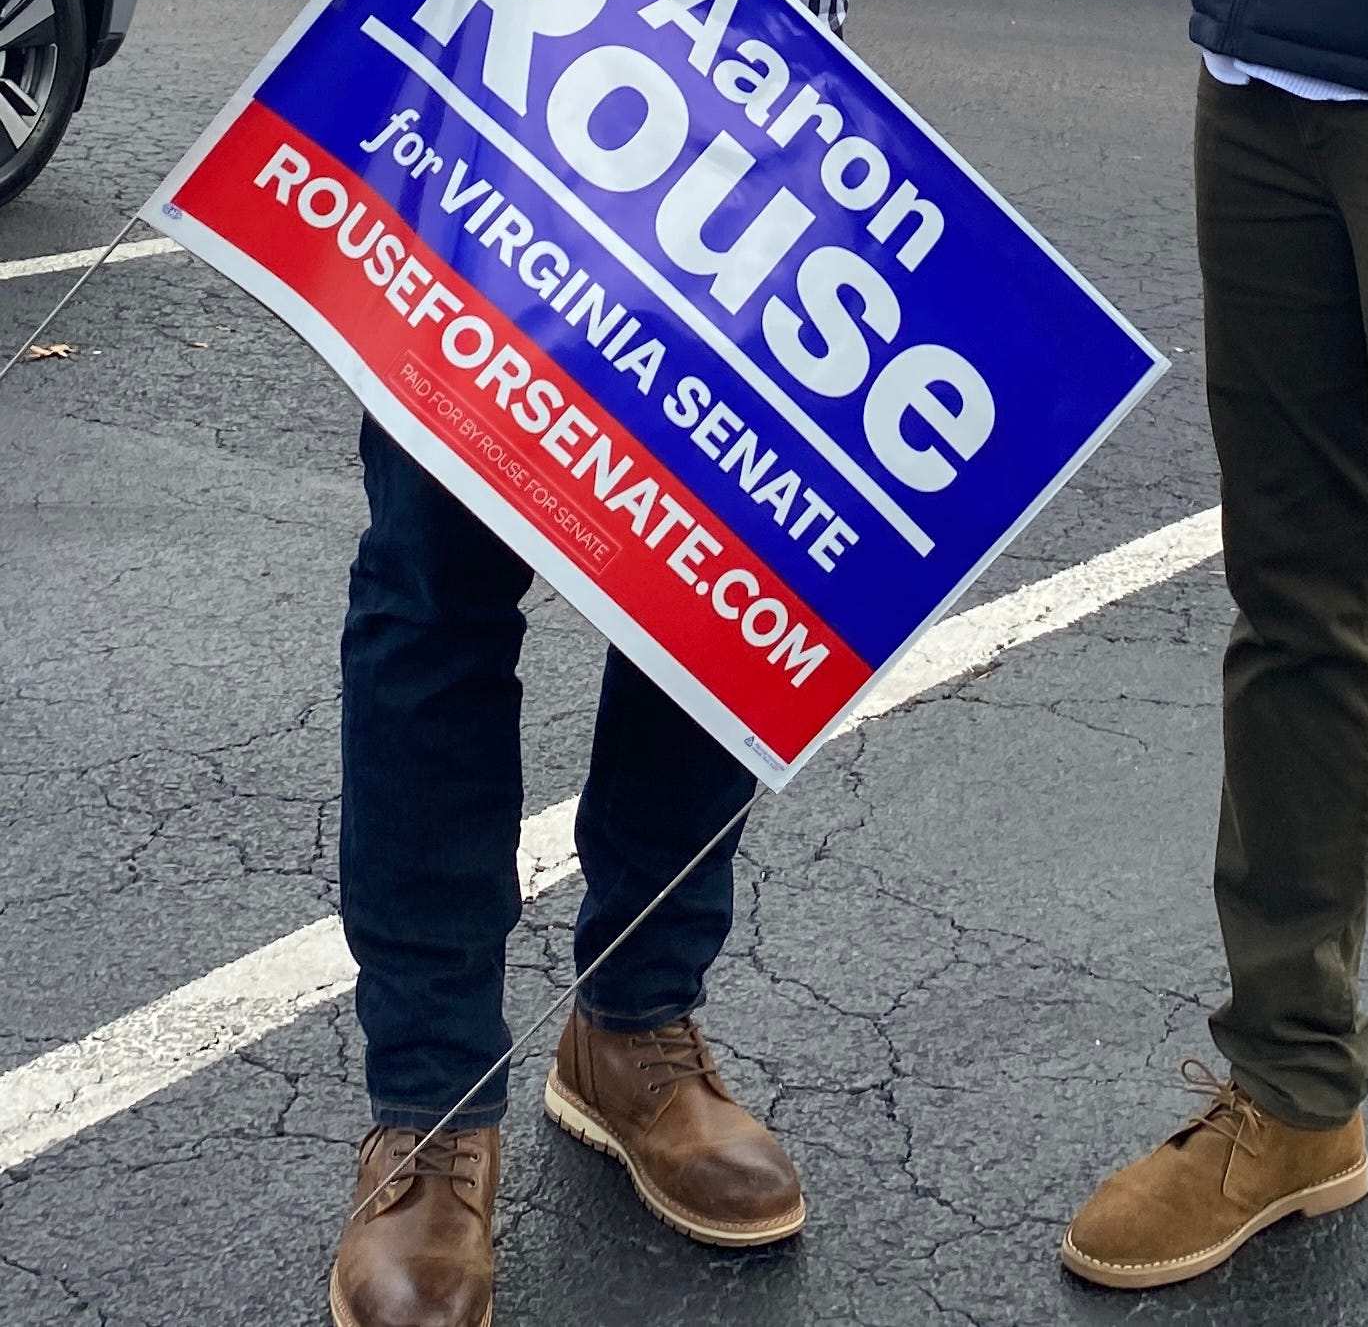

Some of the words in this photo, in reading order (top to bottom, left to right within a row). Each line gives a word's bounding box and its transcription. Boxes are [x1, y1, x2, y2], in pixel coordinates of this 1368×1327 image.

[253, 143, 830, 688] ROUSEFORSENATE.COM
[360, 109, 443, 178] for
[439, 158, 667, 396] VIRGINIA
[663, 376, 860, 573] SENATE
[401, 363, 432, 397] PAID
[428, 391, 463, 426] FOR
[458, 419, 482, 441] BY
[476, 435, 530, 487] ROUSE
[525, 478, 557, 513] FOR
[554, 508, 609, 562] SENATE
